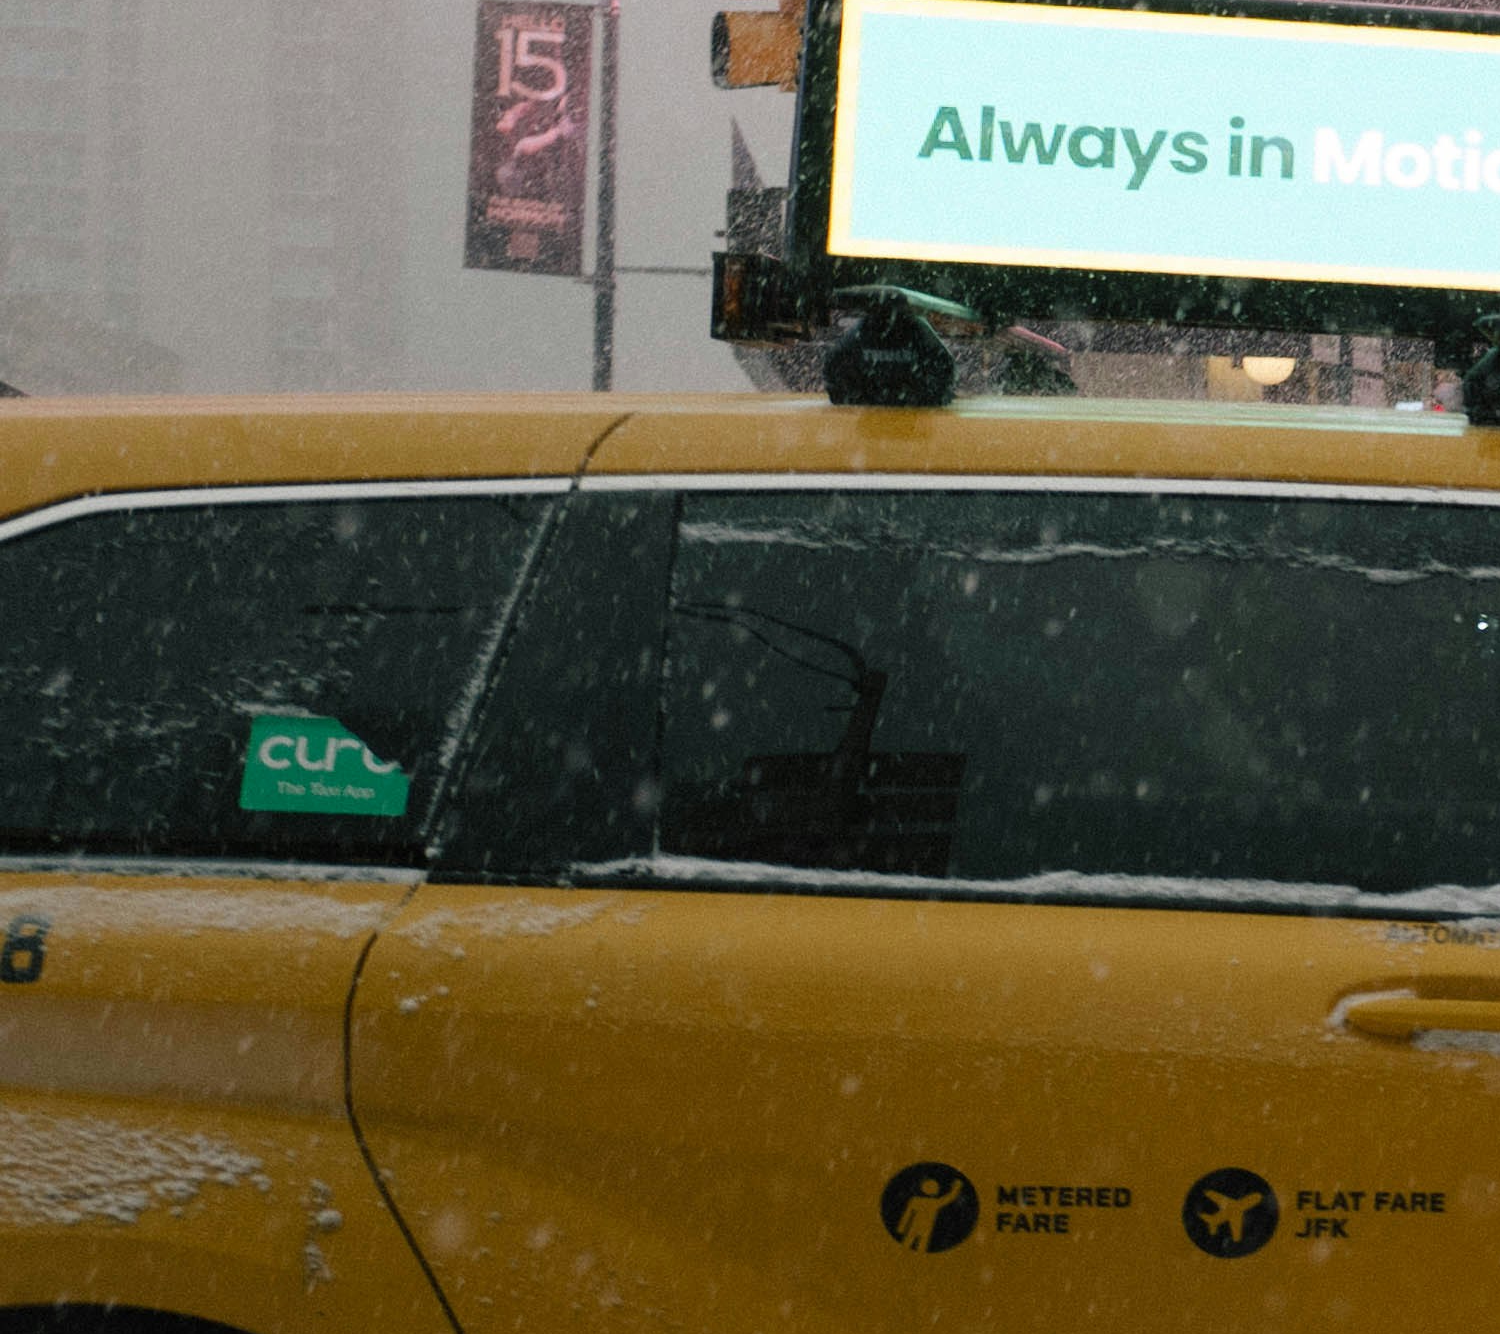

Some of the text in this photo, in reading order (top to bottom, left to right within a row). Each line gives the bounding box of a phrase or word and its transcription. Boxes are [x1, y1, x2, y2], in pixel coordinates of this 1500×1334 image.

[495, 27, 568, 101] 15
[917, 104, 1210, 191] Always
[1227, 115, 1295, 179] in
[996, 1186, 1132, 1209] METERED
[1297, 1191, 1446, 1215] FLAT FARE
[996, 1212, 1070, 1234] FARE
[1296, 1218, 1350, 1240] JFK
